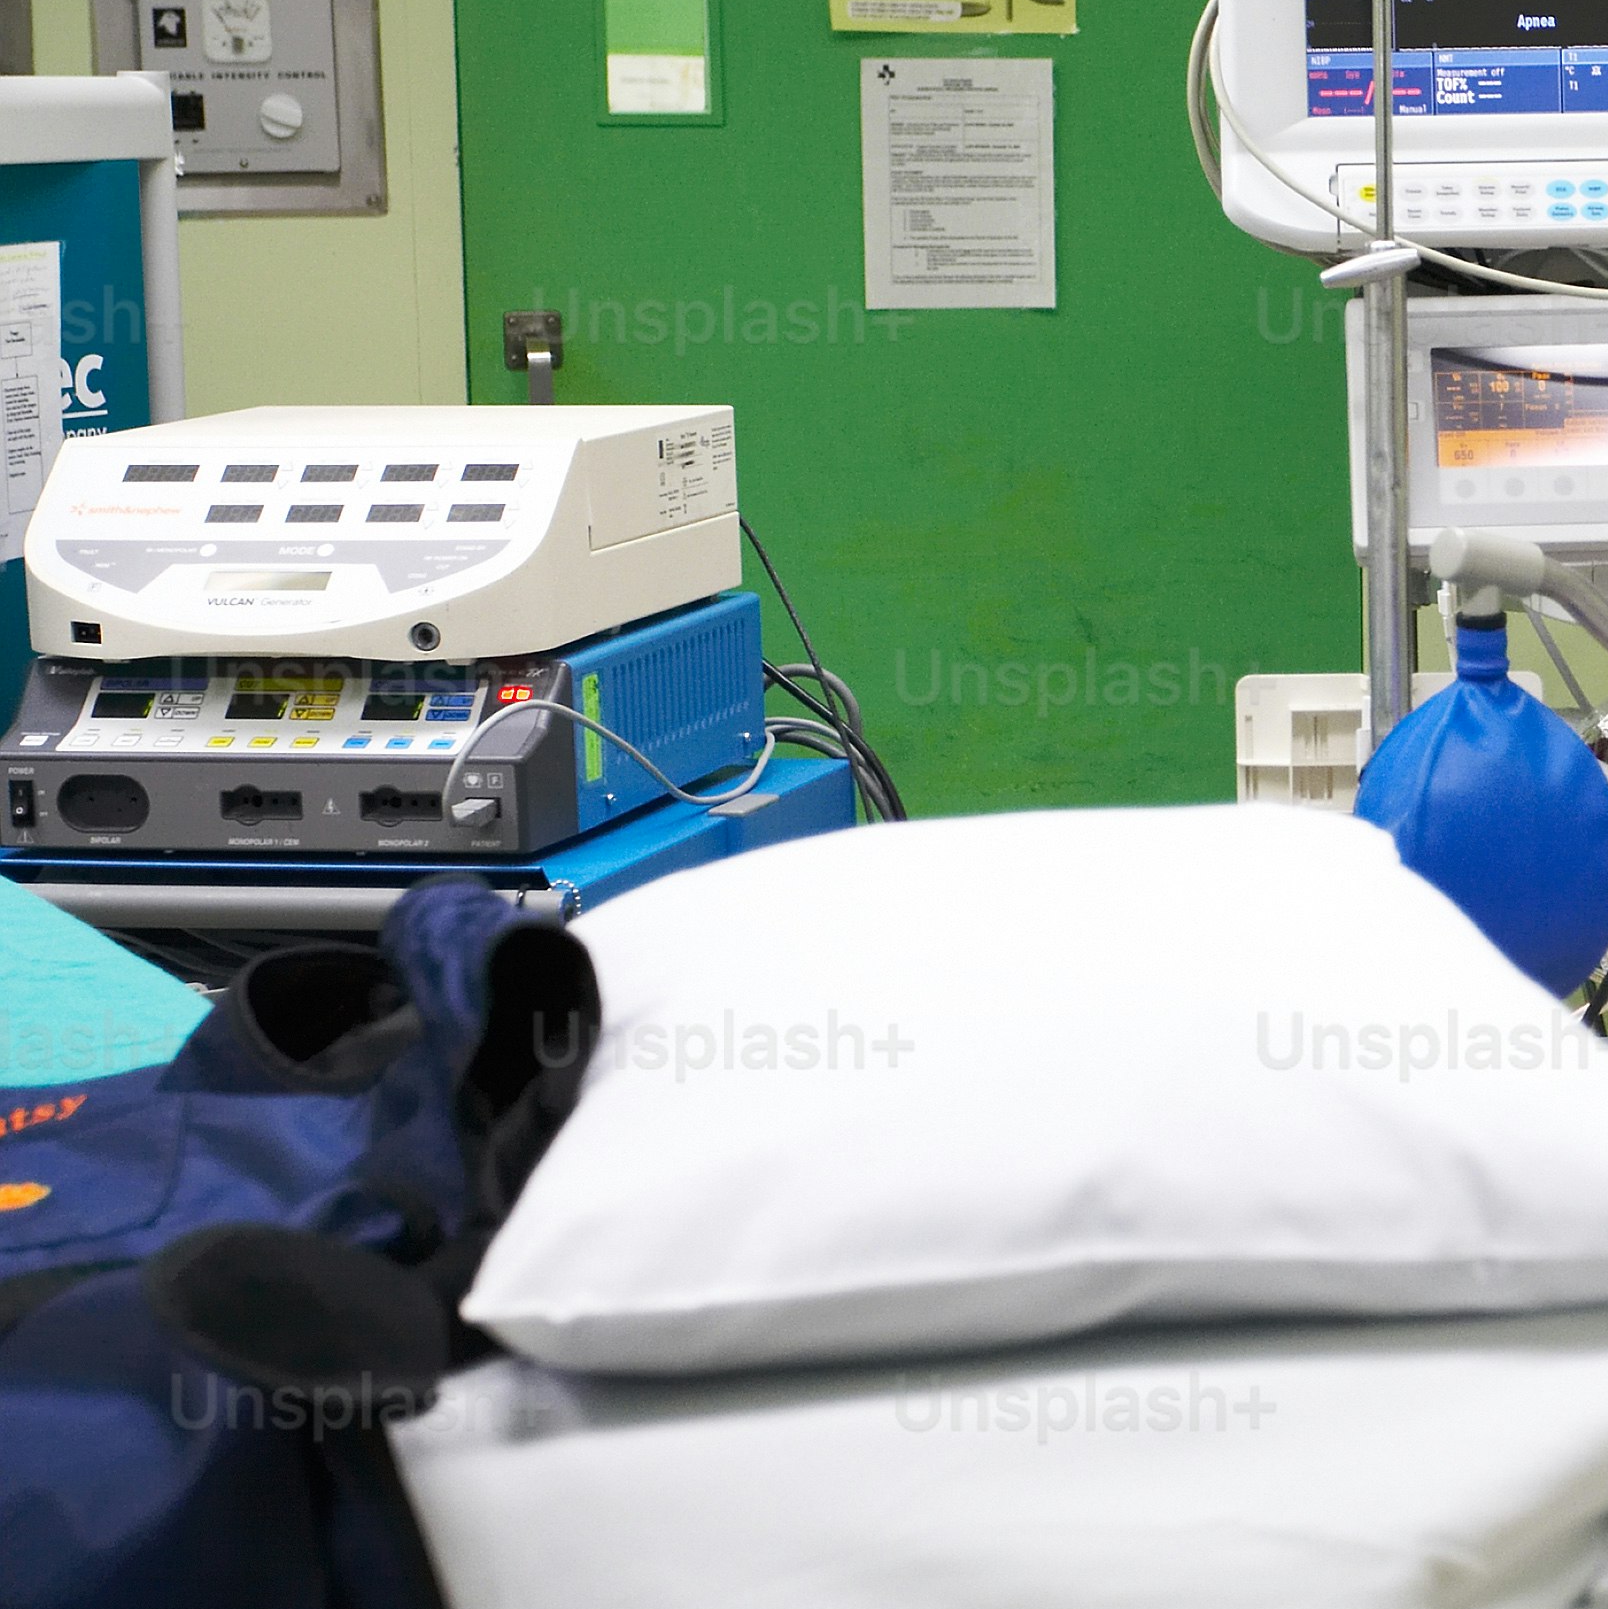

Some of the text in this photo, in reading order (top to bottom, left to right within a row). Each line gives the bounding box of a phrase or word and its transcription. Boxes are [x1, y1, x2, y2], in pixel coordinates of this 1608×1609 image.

[1517, 15, 1556, 30] Apnea
[211, 71, 326, 80] INTENSITY CONTROL
[1437, 78, 1468, 90] TOF%
[1437, 90, 1475, 104] Count
[1399, 104, 1427, 113] Manual
[60, 353, 107, 410] ec
[279, 546, 317, 555] MODE
[207, 598, 312, 606] VULCAN Generator
[8, 767, 35, 775] POWER
